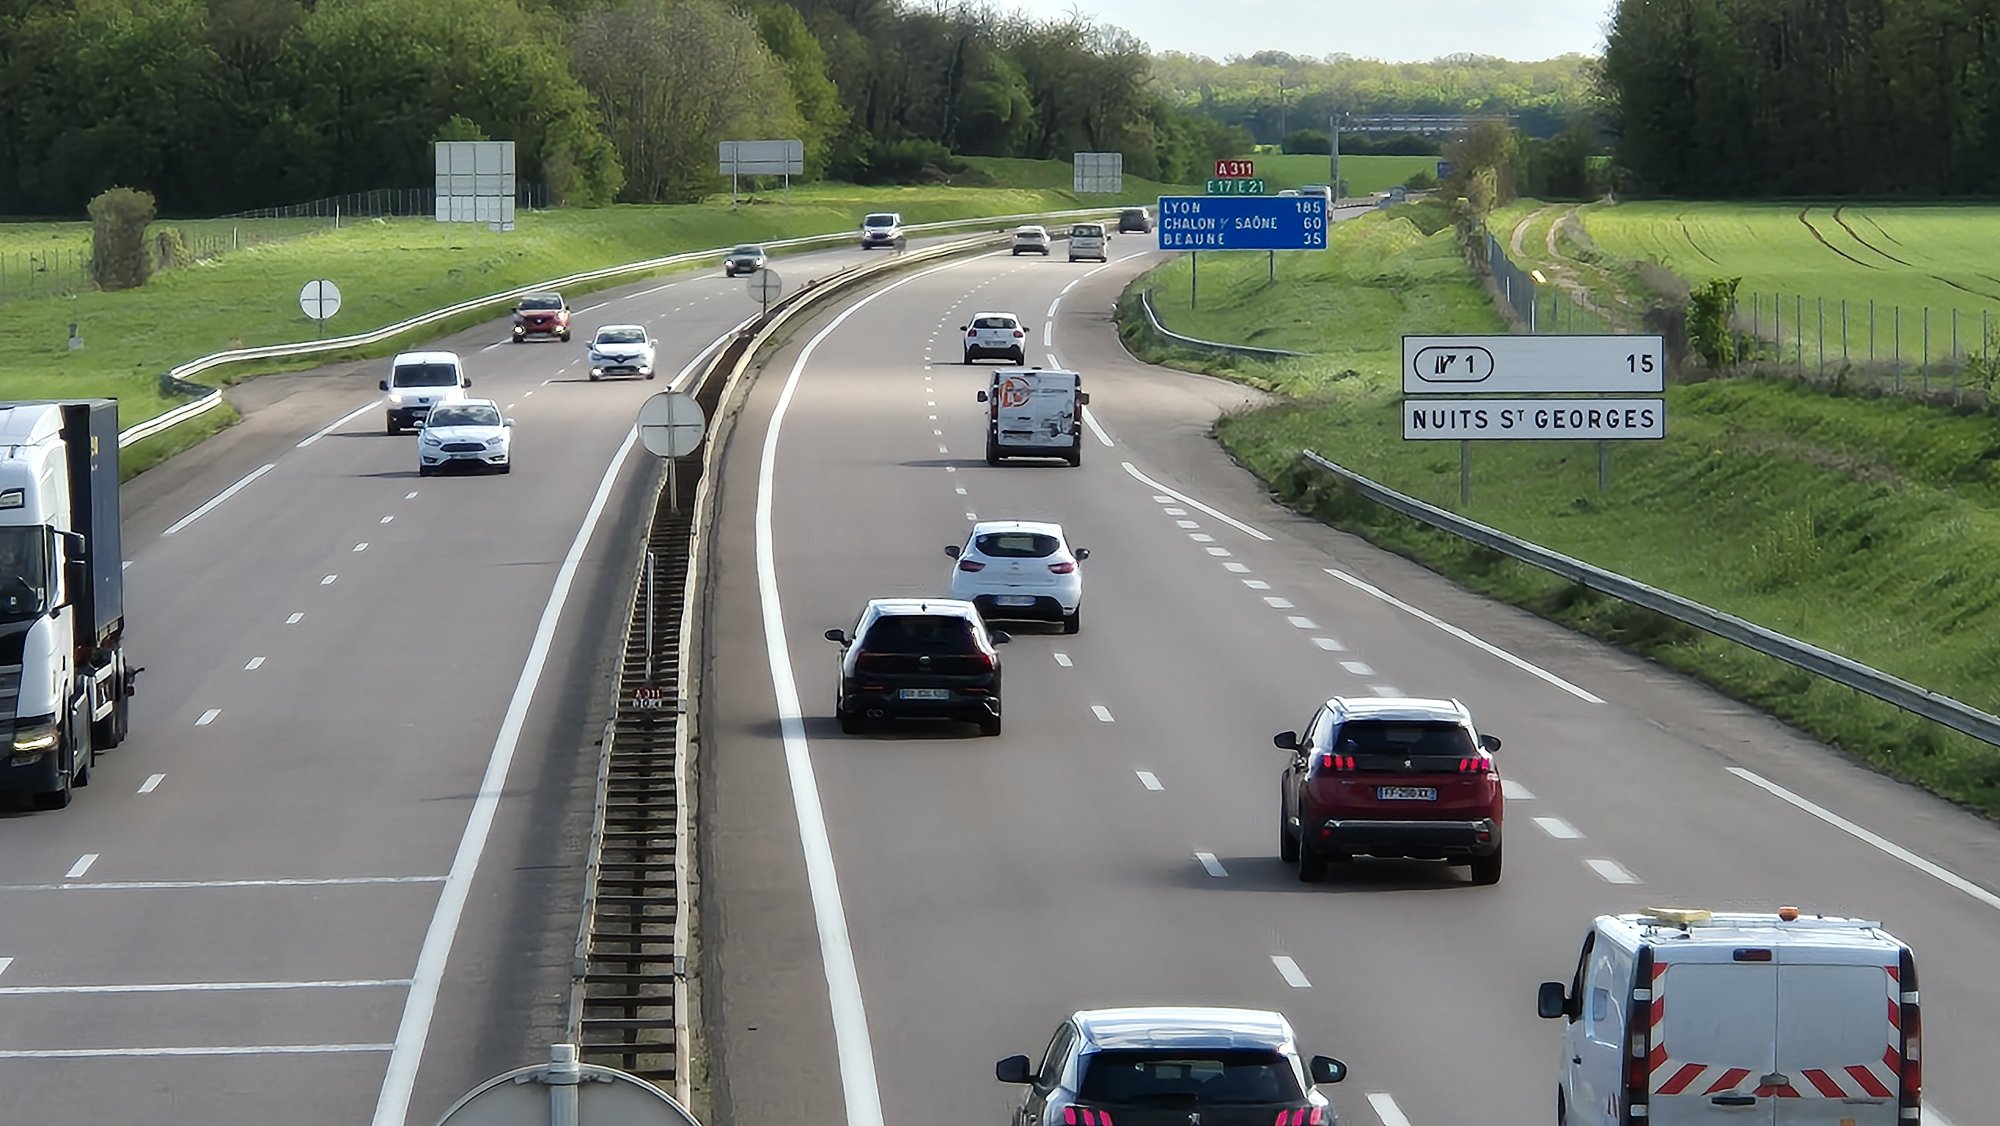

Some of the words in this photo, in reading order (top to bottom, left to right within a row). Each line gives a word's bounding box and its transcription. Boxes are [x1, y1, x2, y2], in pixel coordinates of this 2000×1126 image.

[1218, 163, 1227, 175] A
[1230, 162, 1252, 175] 311
[1207, 181, 1214, 193] E
[1218, 181, 1231, 193] 17
[1238, 181, 1246, 193] E
[1249, 181, 1264, 193] 21
[1164, 202, 1200, 214] LYON
[1296, 202, 1321, 213] 185
[1164, 217, 1215, 230] CHALON
[1235, 215, 1278, 230] SAÔNE
[1303, 217, 1322, 230] 60
[1164, 232, 1225, 245] BEAUNE
[1303, 232, 1322, 245] 35
[1465, 355, 1474, 374] 1
[1626, 354, 1654, 373] 15
[1413, 410, 1488, 430] NUITS
[1534, 409, 1654, 429] GEORGES
